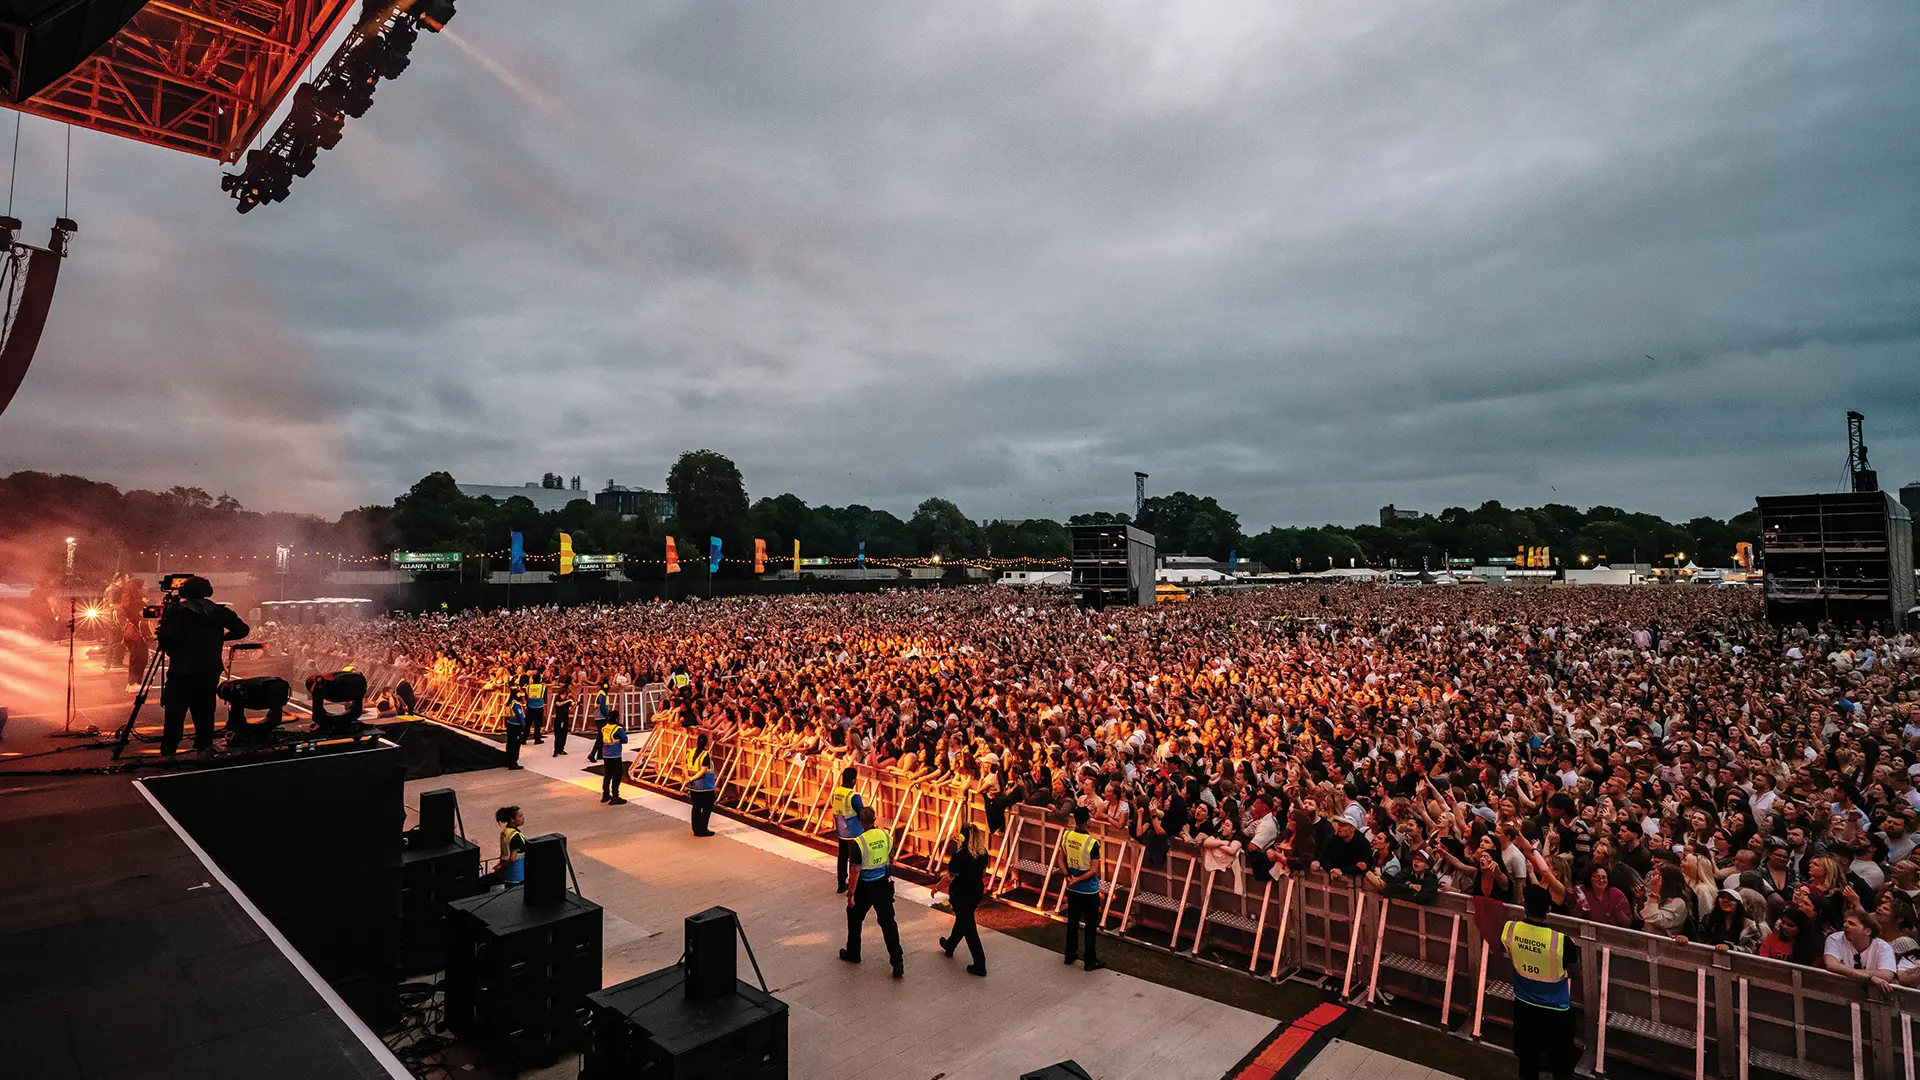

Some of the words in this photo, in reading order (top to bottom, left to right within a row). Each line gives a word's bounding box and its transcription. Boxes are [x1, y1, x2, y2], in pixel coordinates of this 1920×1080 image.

[1515, 936, 1546, 949] RUBICON
[1518, 943, 1542, 954] WALES
[1522, 964, 1540, 974] 180
